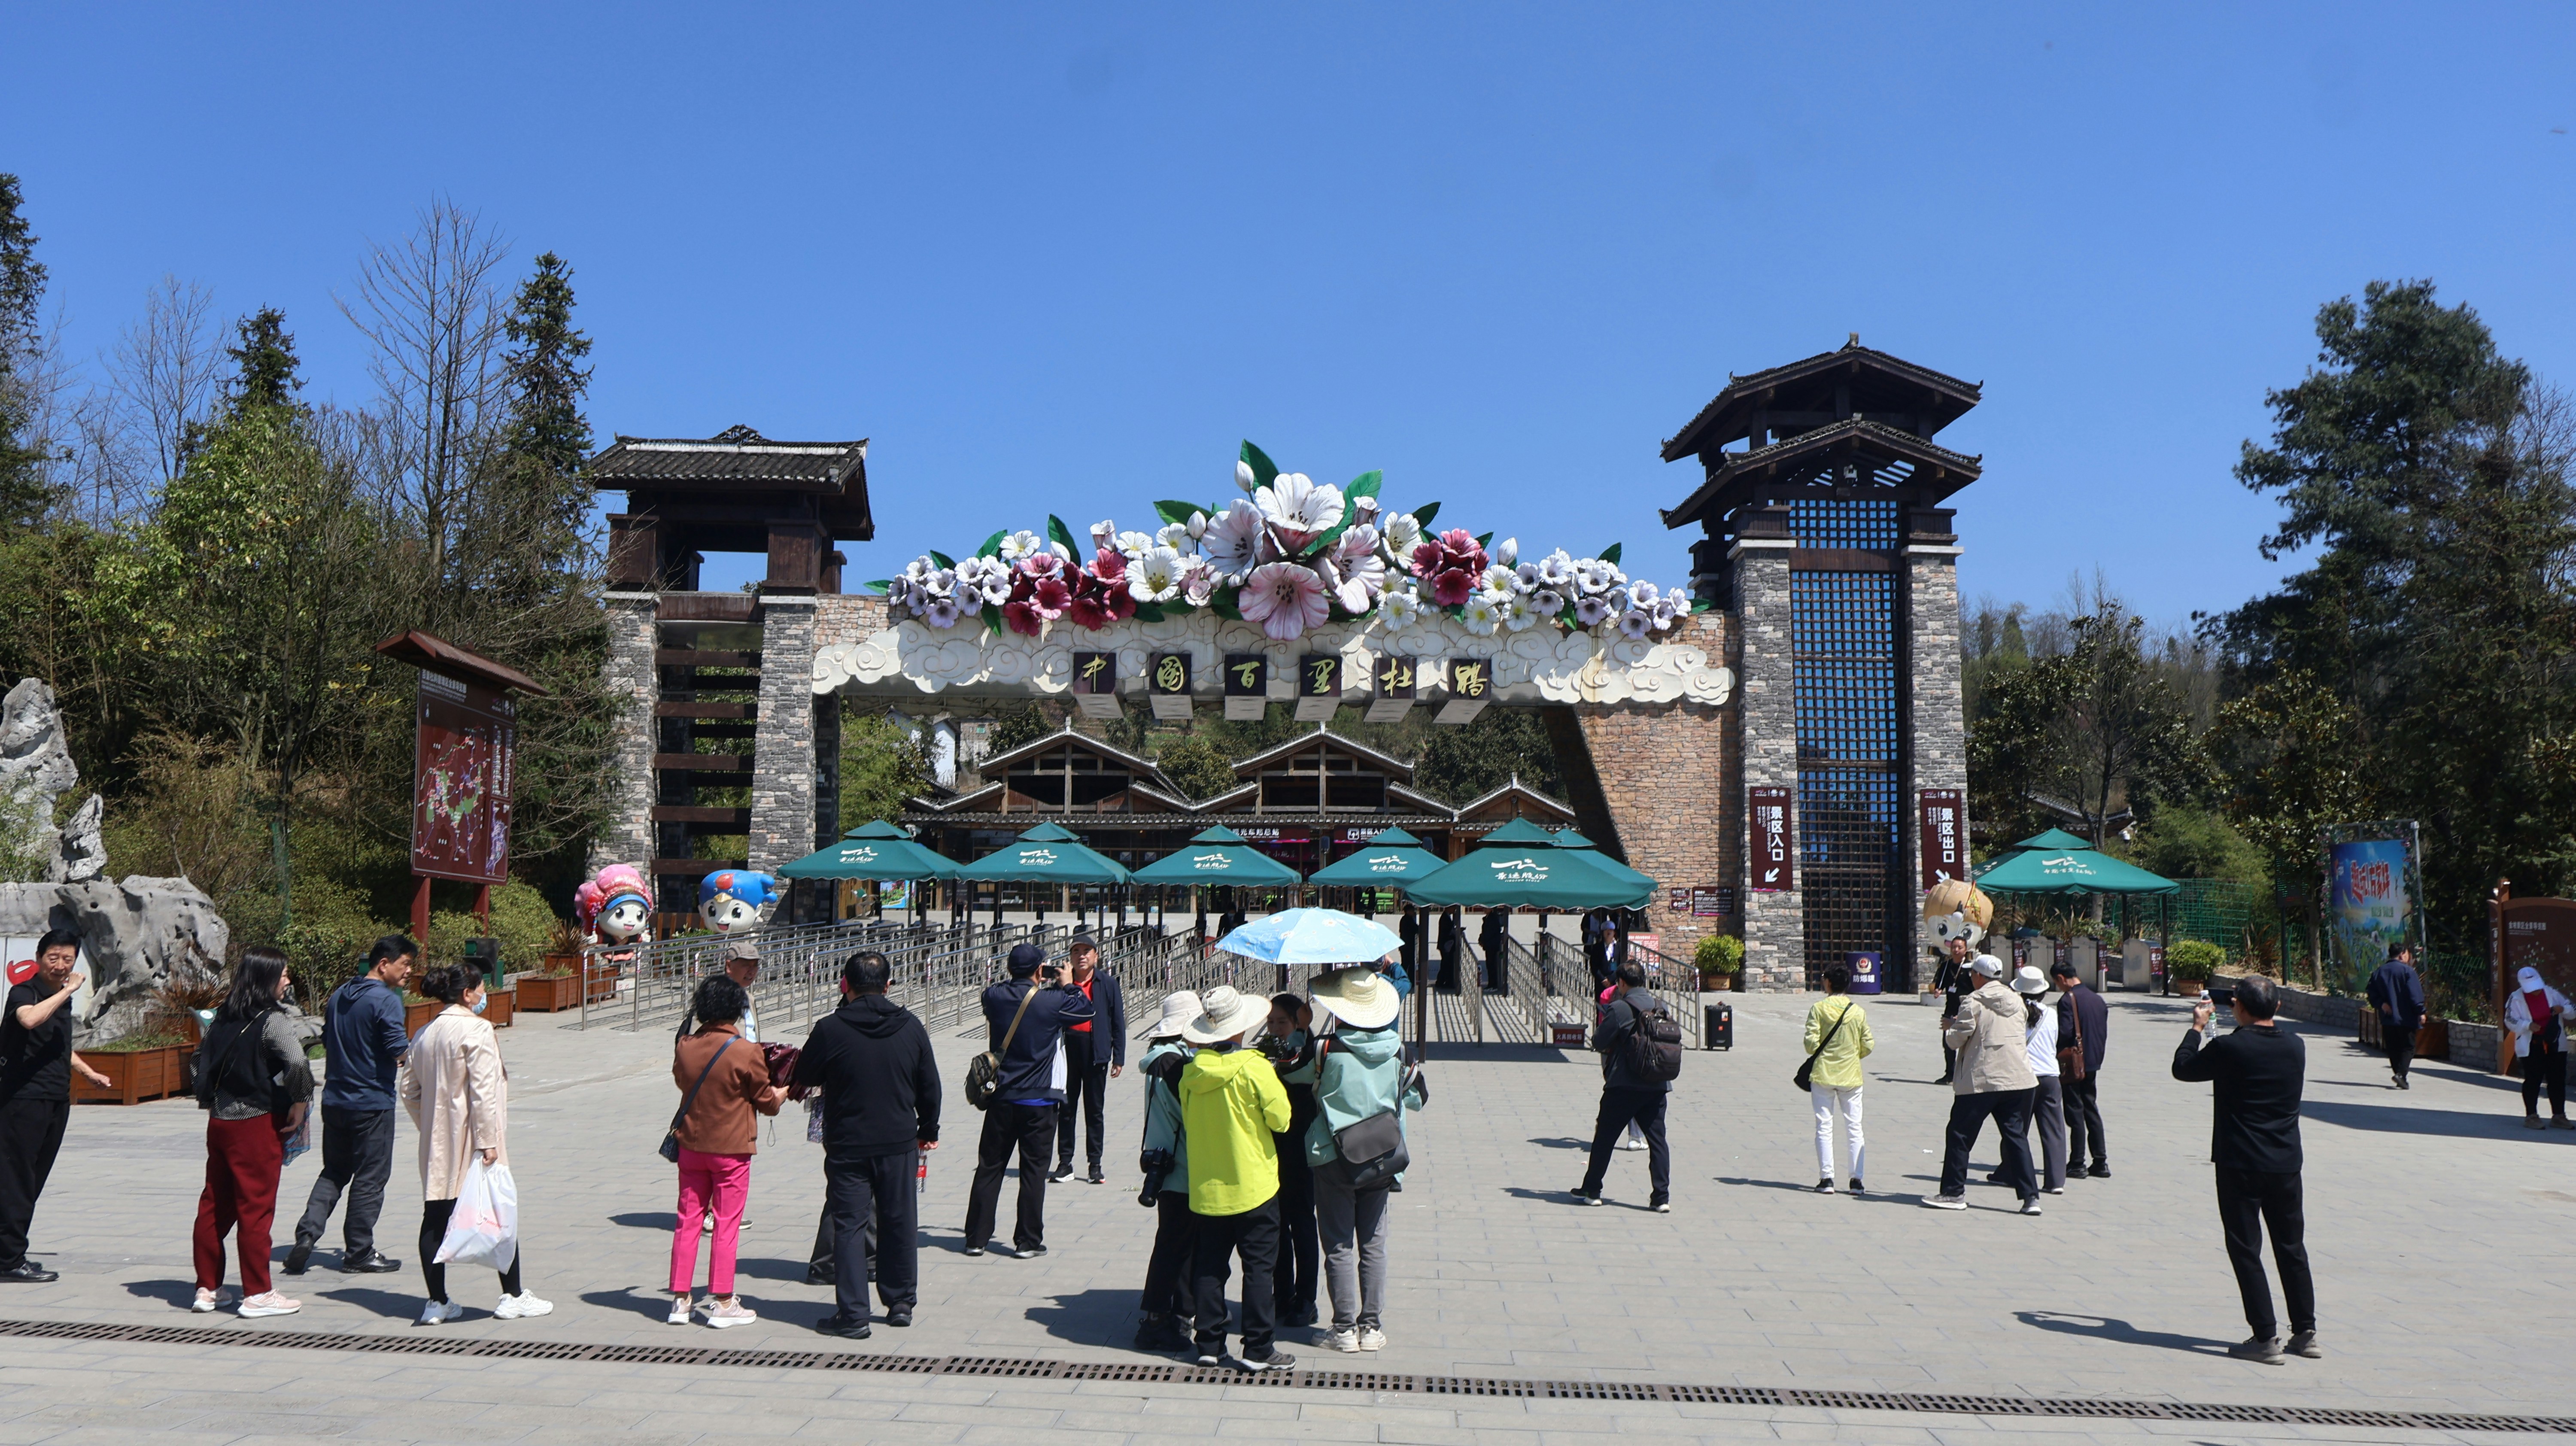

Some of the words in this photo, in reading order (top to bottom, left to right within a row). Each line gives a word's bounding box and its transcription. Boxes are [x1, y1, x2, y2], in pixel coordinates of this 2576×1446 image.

[1771, 806, 1784, 861] 景区入口
[1941, 808, 1955, 863] 景区出口
